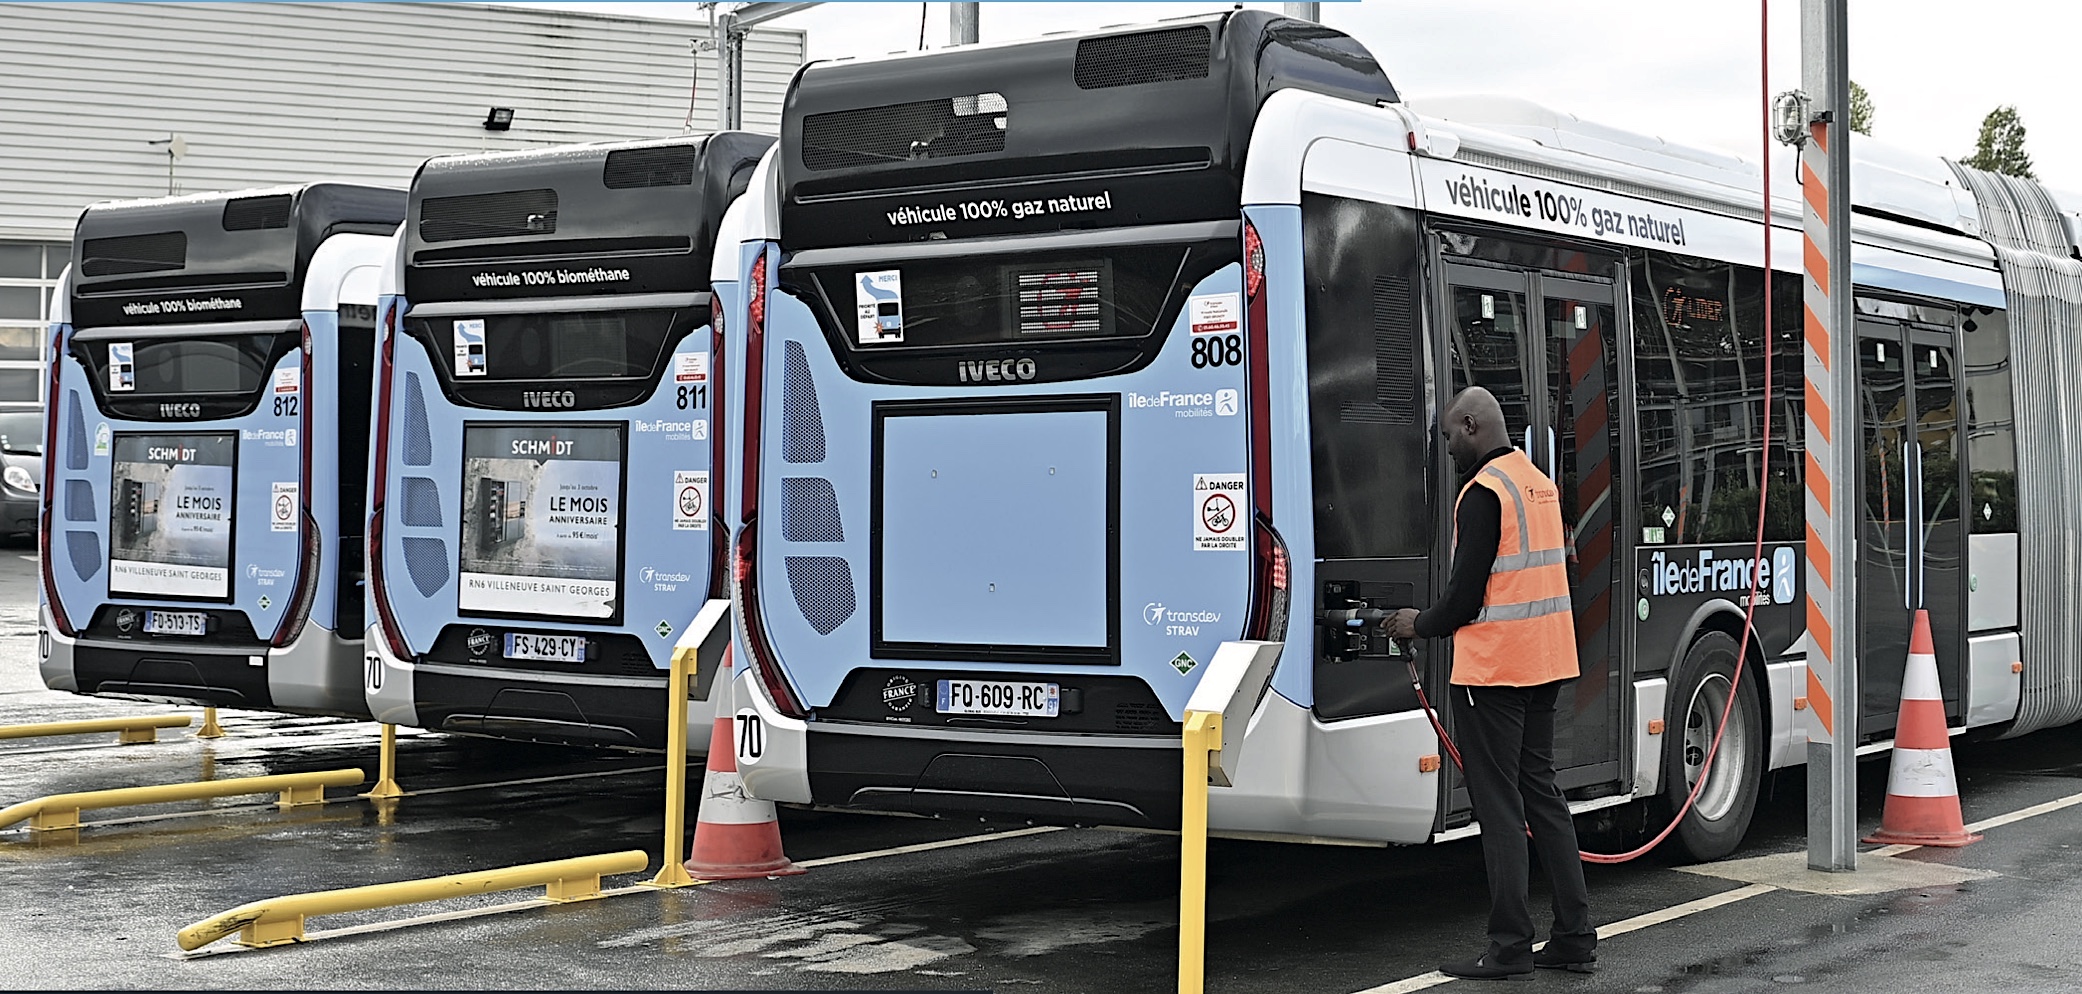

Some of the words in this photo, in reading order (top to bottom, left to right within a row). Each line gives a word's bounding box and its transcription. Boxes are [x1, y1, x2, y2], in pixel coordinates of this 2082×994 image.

[887, 204, 957, 225] véhicule
[959, 200, 1008, 220] 100%
[1011, 200, 1045, 219] gaz
[1048, 190, 1112, 213] naturel
[1446, 174, 1532, 218] véhicule
[1535, 189, 1588, 228] 100%
[1592, 207, 1625, 237] gaz
[1628, 212, 1687, 246] naturel
[472, 271, 521, 286] véhicule
[521, 271, 556, 285] 100%
[556, 267, 630, 284] biométhane
[122, 302, 160, 315] véhicule
[160, 300, 186, 313] 100%
[187, 297, 242, 311] biométhane
[1191, 334, 1242, 370] 808
[958, 358, 1036, 382] IVECO
[523, 391, 575, 408] IVECO
[676, 385, 706, 410] 811
[160, 403, 200, 417] IVECO
[273, 396, 298, 417] 812
[1175, 407, 1213, 418] mobilités
[1209, 481, 1244, 490] DANGER
[177, 496, 190, 509] LE
[192, 497, 222, 510] MOIS
[550, 496, 566, 512] LE
[570, 497, 608, 513] MOIS
[176, 512, 221, 521] ANNIVERSAIRE
[549, 515, 608, 525] ANNIVERSAIRE
[114, 565, 127, 574] RN6
[128, 566, 167, 578] VILLENEUVE
[169, 569, 189, 579] SAINT
[190, 571, 222, 581] GEORGES
[654, 571, 690, 582] transdev
[469, 579, 485, 589] RN6
[487, 579, 538, 592] VILLENEUVE
[541, 583, 566, 594] SAINT
[569, 585, 610, 597] GEORGES
[654, 584, 677, 592] STRAV
[1166, 610, 1221, 623] transdev
[1166, 625, 1200, 636] STRAV
[38, 630, 49, 659] 70
[1174, 658, 1193, 668] GNC
[366, 656, 382, 689] 70
[883, 685, 916, 699] FRANCE
[736, 715, 762, 758] 70
